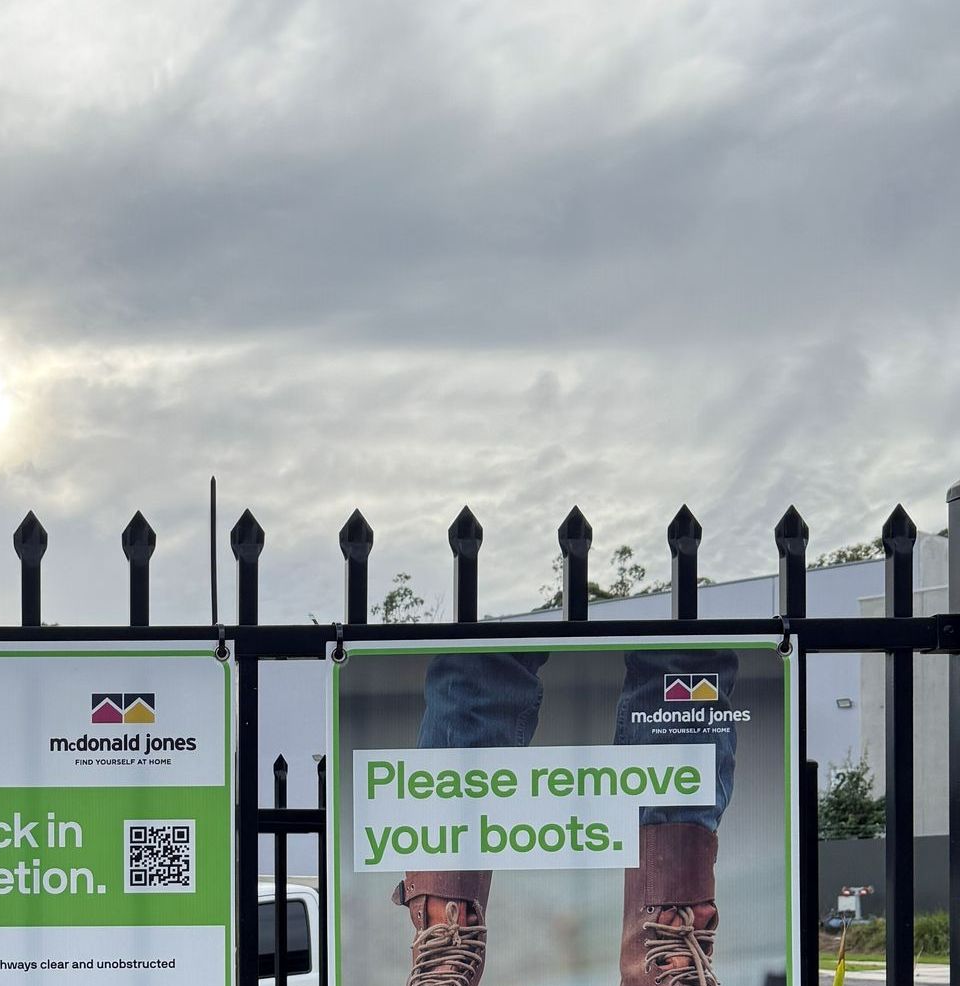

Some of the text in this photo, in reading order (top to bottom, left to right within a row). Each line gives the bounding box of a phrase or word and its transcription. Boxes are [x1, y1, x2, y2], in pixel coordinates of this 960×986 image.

[707, 707, 750, 725] jones
[143, 733, 196, 755] jones
[367, 760, 700, 799] Please remove
[47, 812, 82, 847] in
[364, 814, 622, 865] your boots.
[40, 958, 69, 969] clear
[71, 958, 93, 969] and
[96, 958, 175, 968] unobstructed
